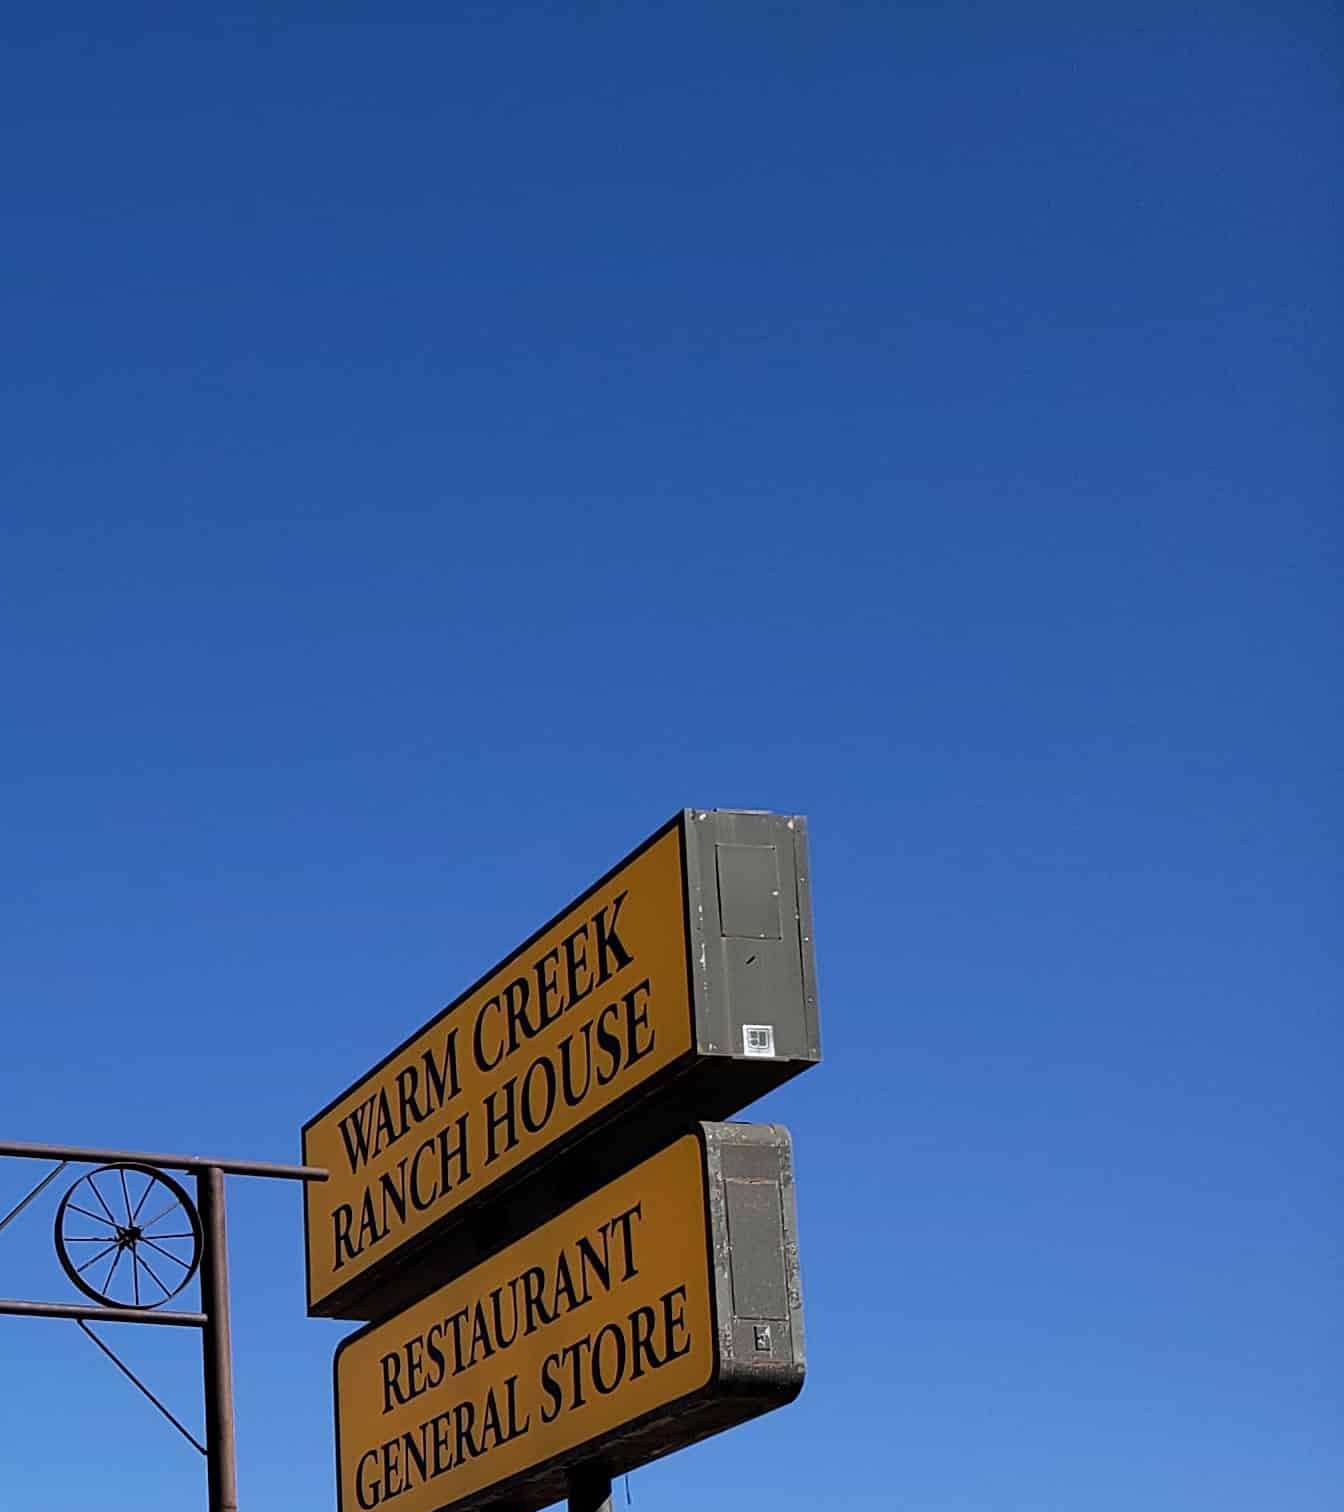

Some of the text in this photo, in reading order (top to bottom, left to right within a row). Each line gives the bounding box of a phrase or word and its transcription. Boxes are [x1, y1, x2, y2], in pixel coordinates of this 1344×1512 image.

[331, 978, 656, 1272] RANCH HOUSE
[338, 890, 634, 1174] WARM CREEK
[355, 1285, 691, 1511] GENERAL STORE
[379, 1203, 642, 1415] RESTAURANT
